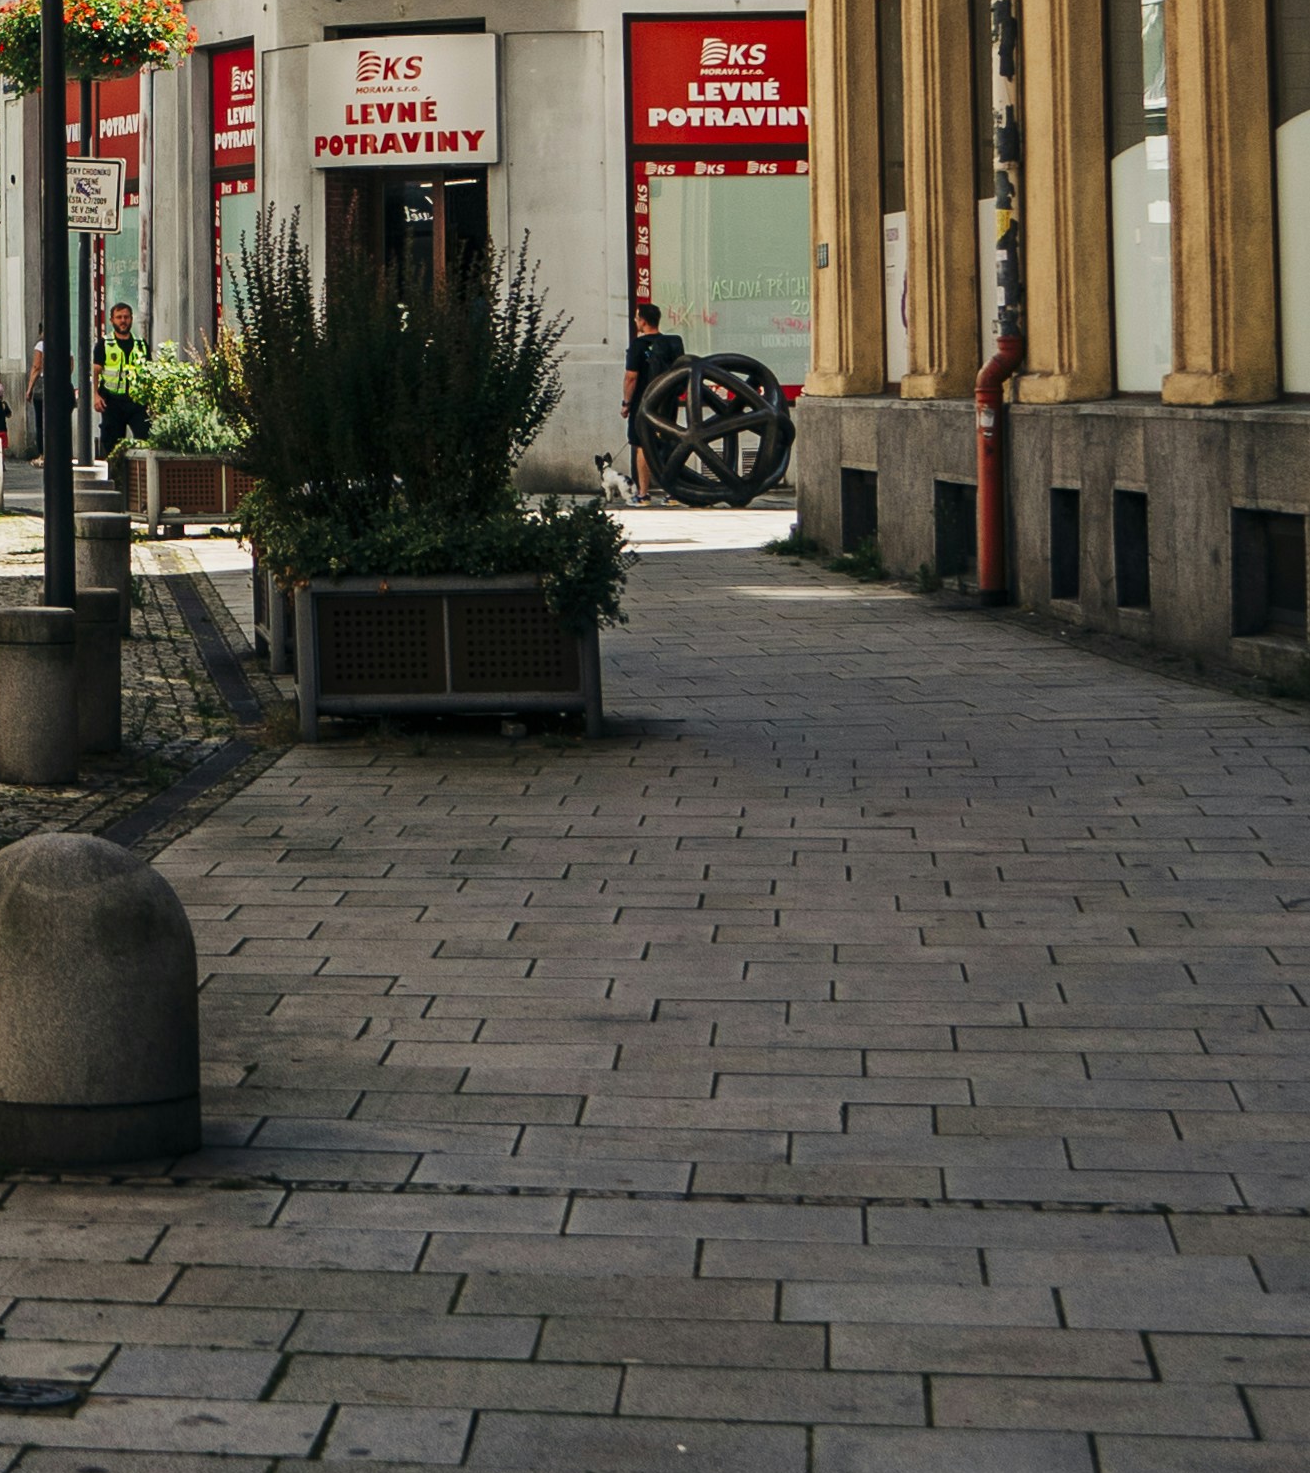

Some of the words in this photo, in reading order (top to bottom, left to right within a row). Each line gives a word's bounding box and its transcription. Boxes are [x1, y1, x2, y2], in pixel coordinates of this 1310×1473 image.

[355, 85, 394, 94] MORAVA
[688, 78, 780, 101] LEVNÉ
[346, 96, 437, 125] LEVNÉ
[315, 130, 485, 157] POTRAVINY
